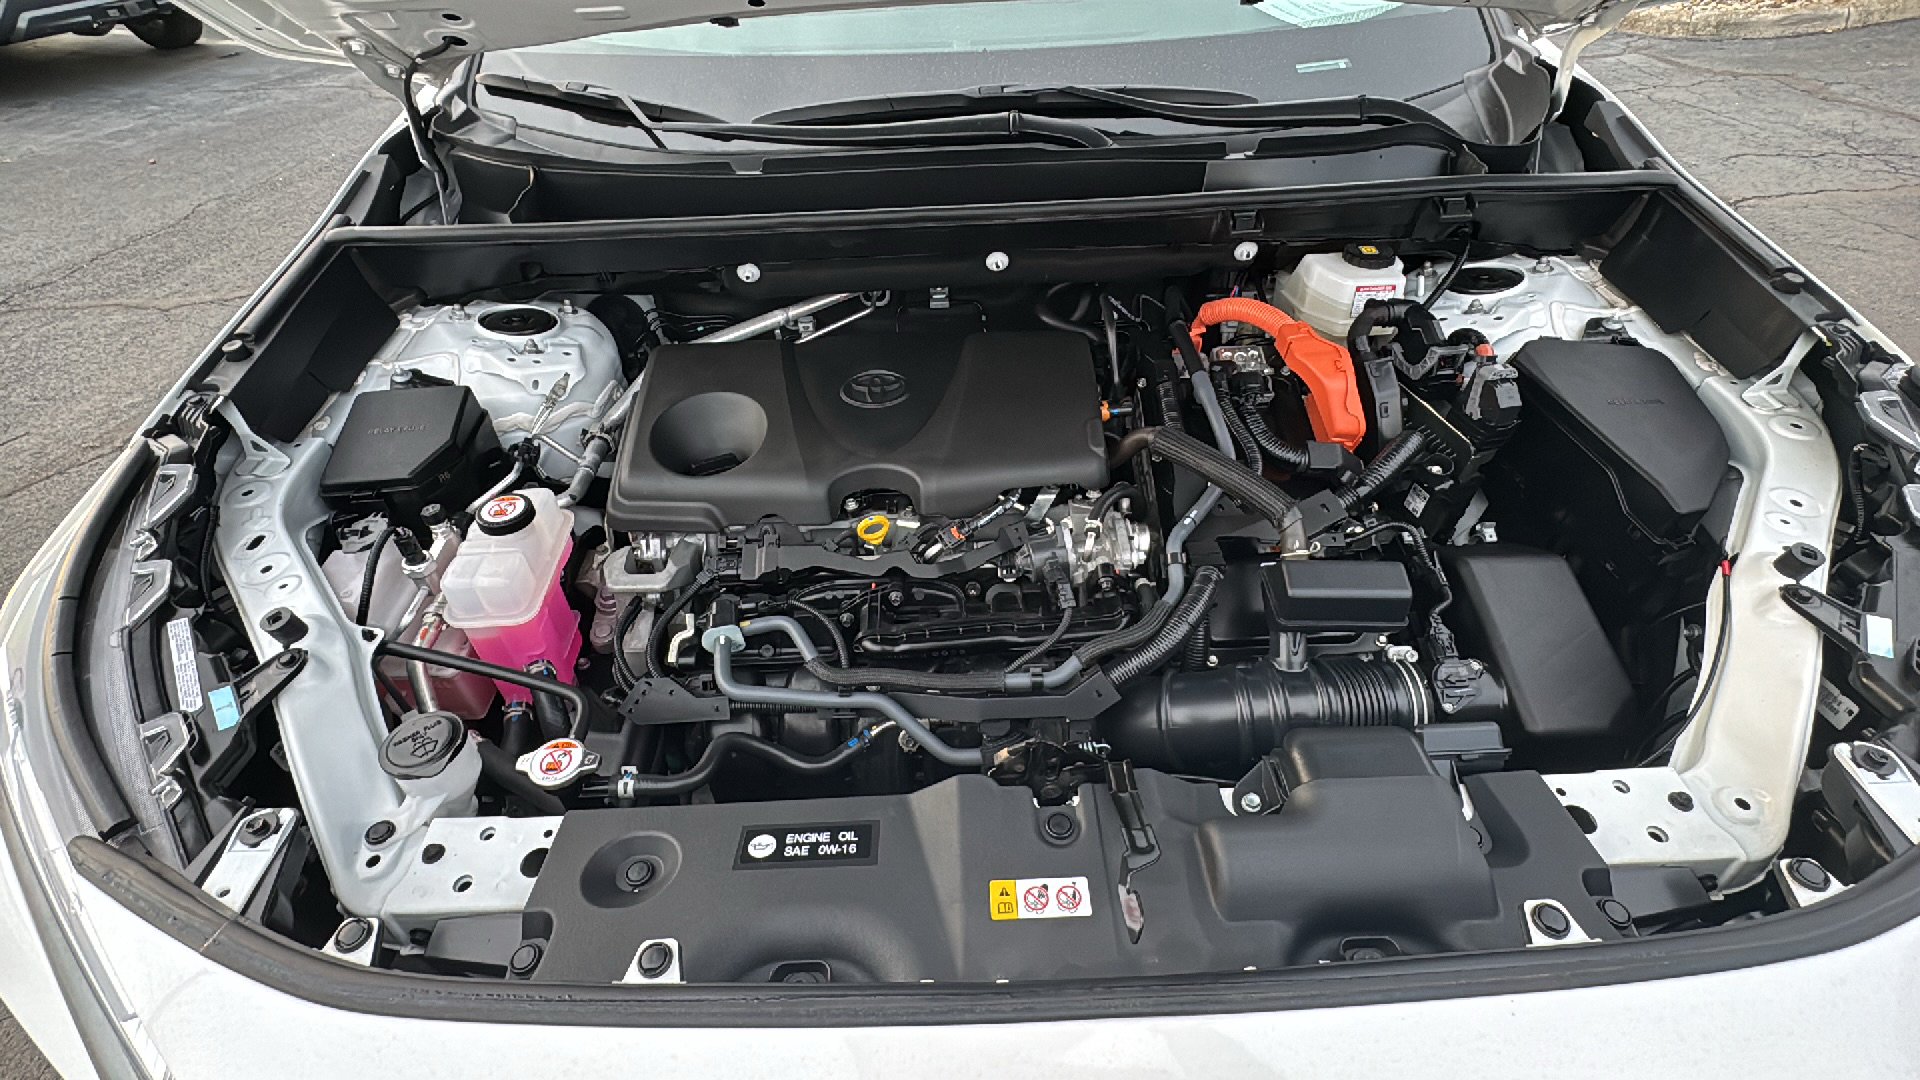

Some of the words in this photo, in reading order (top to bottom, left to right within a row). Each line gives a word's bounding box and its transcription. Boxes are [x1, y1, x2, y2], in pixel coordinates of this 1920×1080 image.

[785, 832, 831, 844] ENGINE
[837, 831, 859, 841] OIL
[783, 845, 810, 857] SAE
[818, 843, 857, 855] 0W-16
